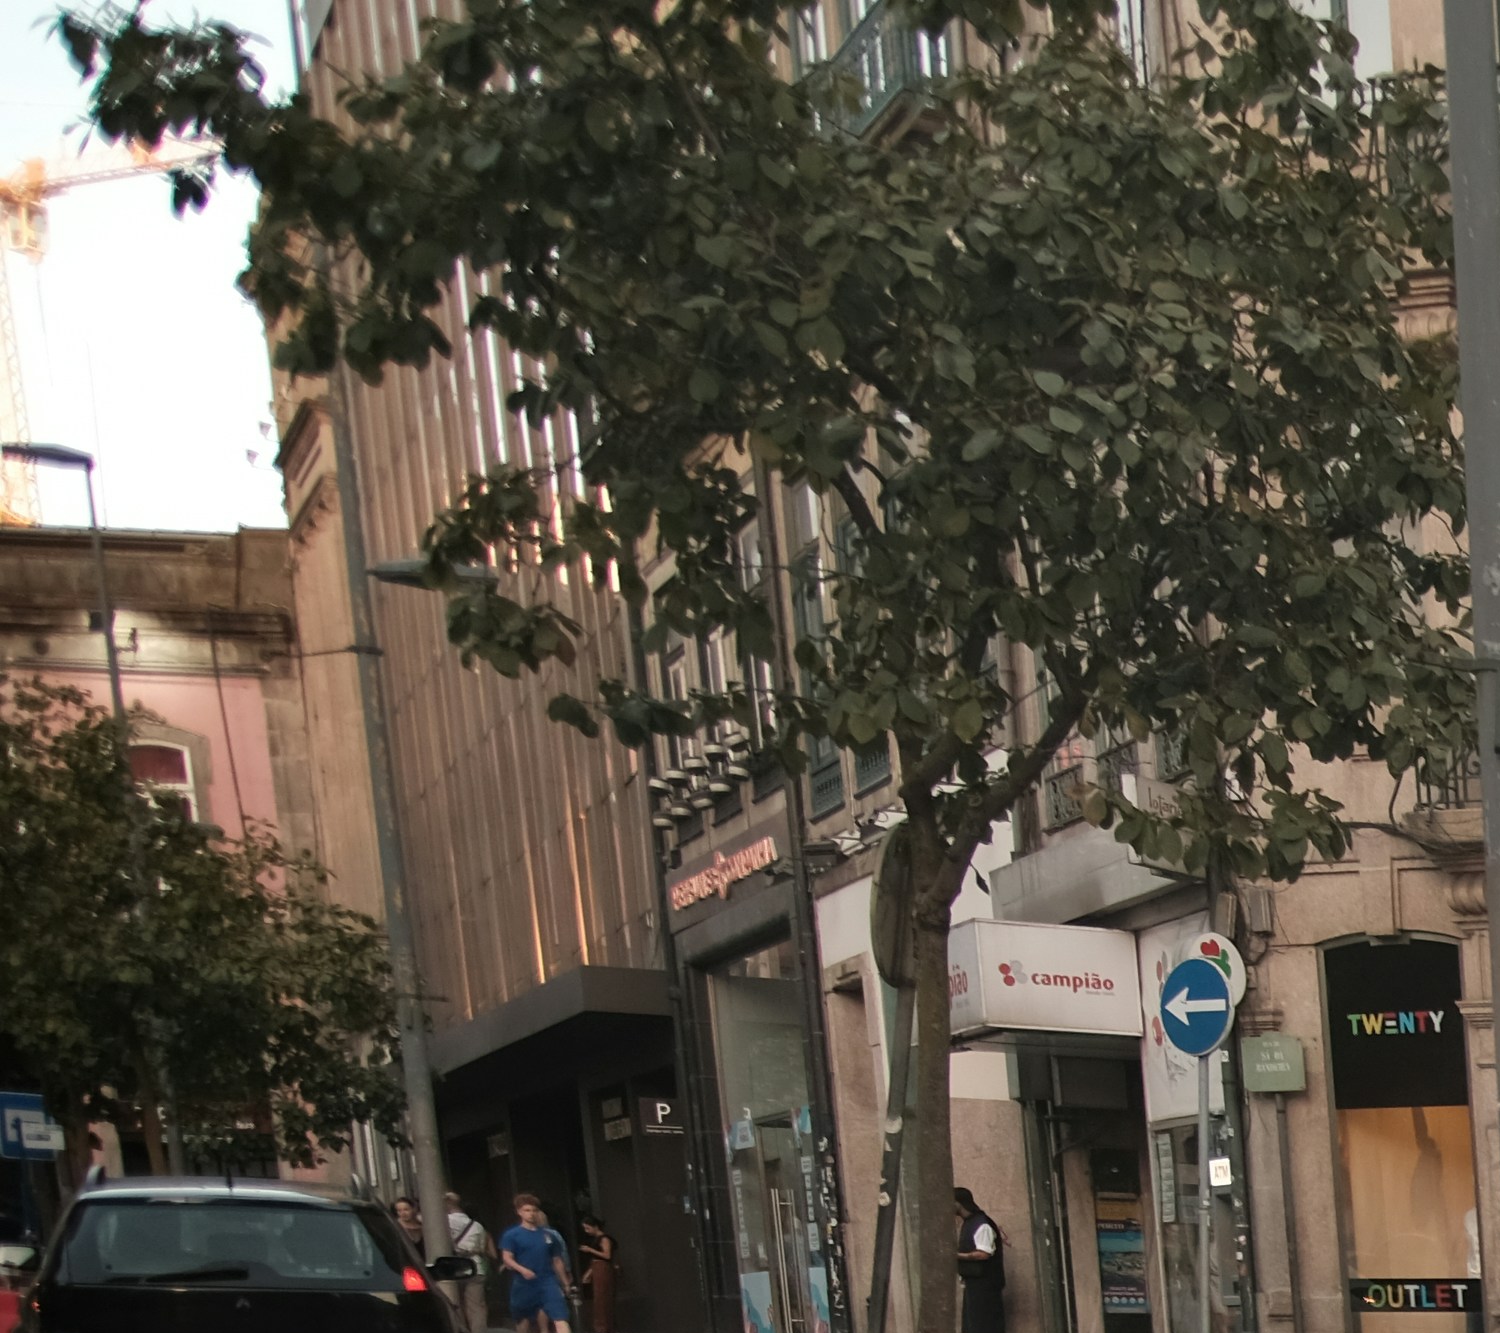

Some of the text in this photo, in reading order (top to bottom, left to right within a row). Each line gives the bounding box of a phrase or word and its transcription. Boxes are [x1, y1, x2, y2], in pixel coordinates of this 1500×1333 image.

[1031, 972, 1115, 994] campião
[1347, 1010, 1444, 1036] TWENTY
[656, 1102, 671, 1124] P
[1367, 1284, 1468, 1308] OUTLET
